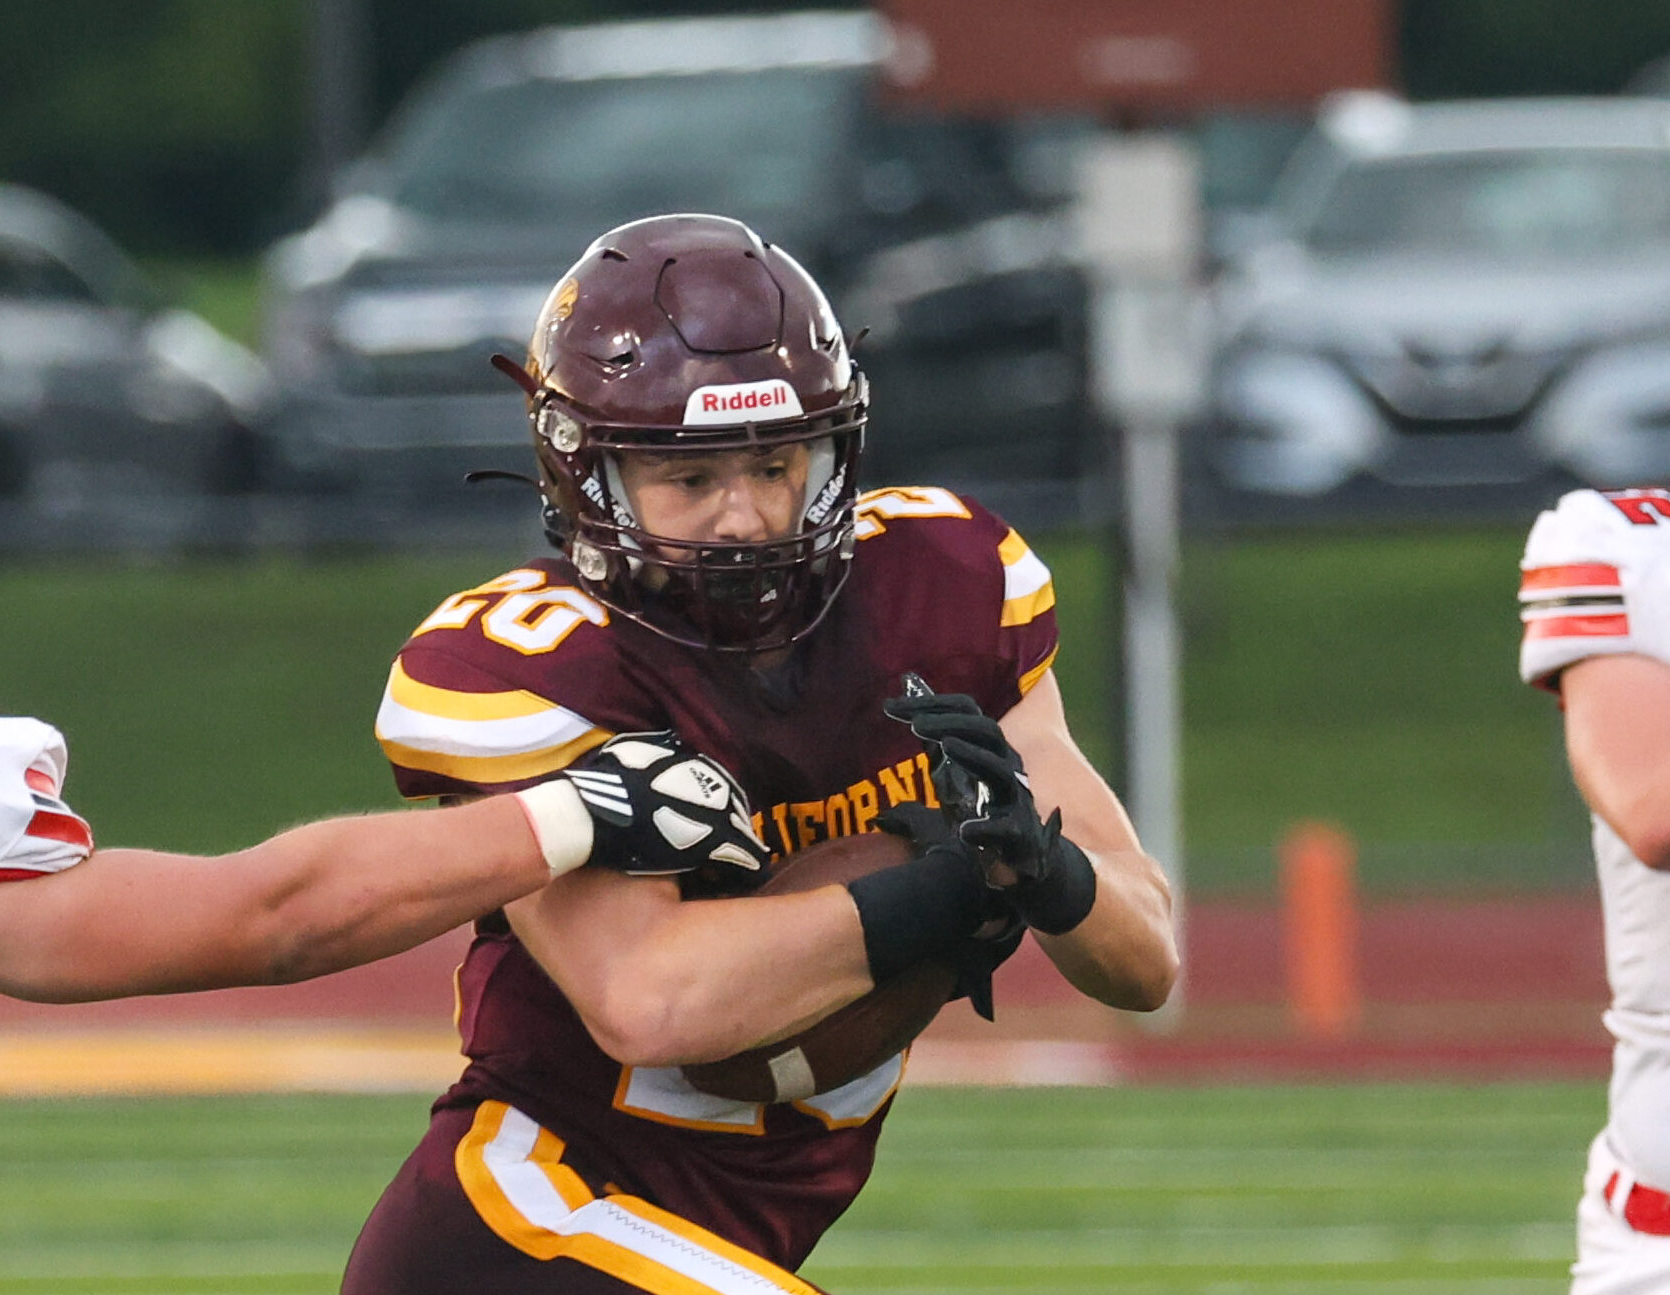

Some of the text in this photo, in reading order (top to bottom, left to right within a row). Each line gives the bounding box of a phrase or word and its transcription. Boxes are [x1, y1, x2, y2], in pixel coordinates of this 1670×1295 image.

[702, 386, 787, 412] Riddell
[806, 463, 848, 525] Ridde
[411, 568, 611, 656] 20
